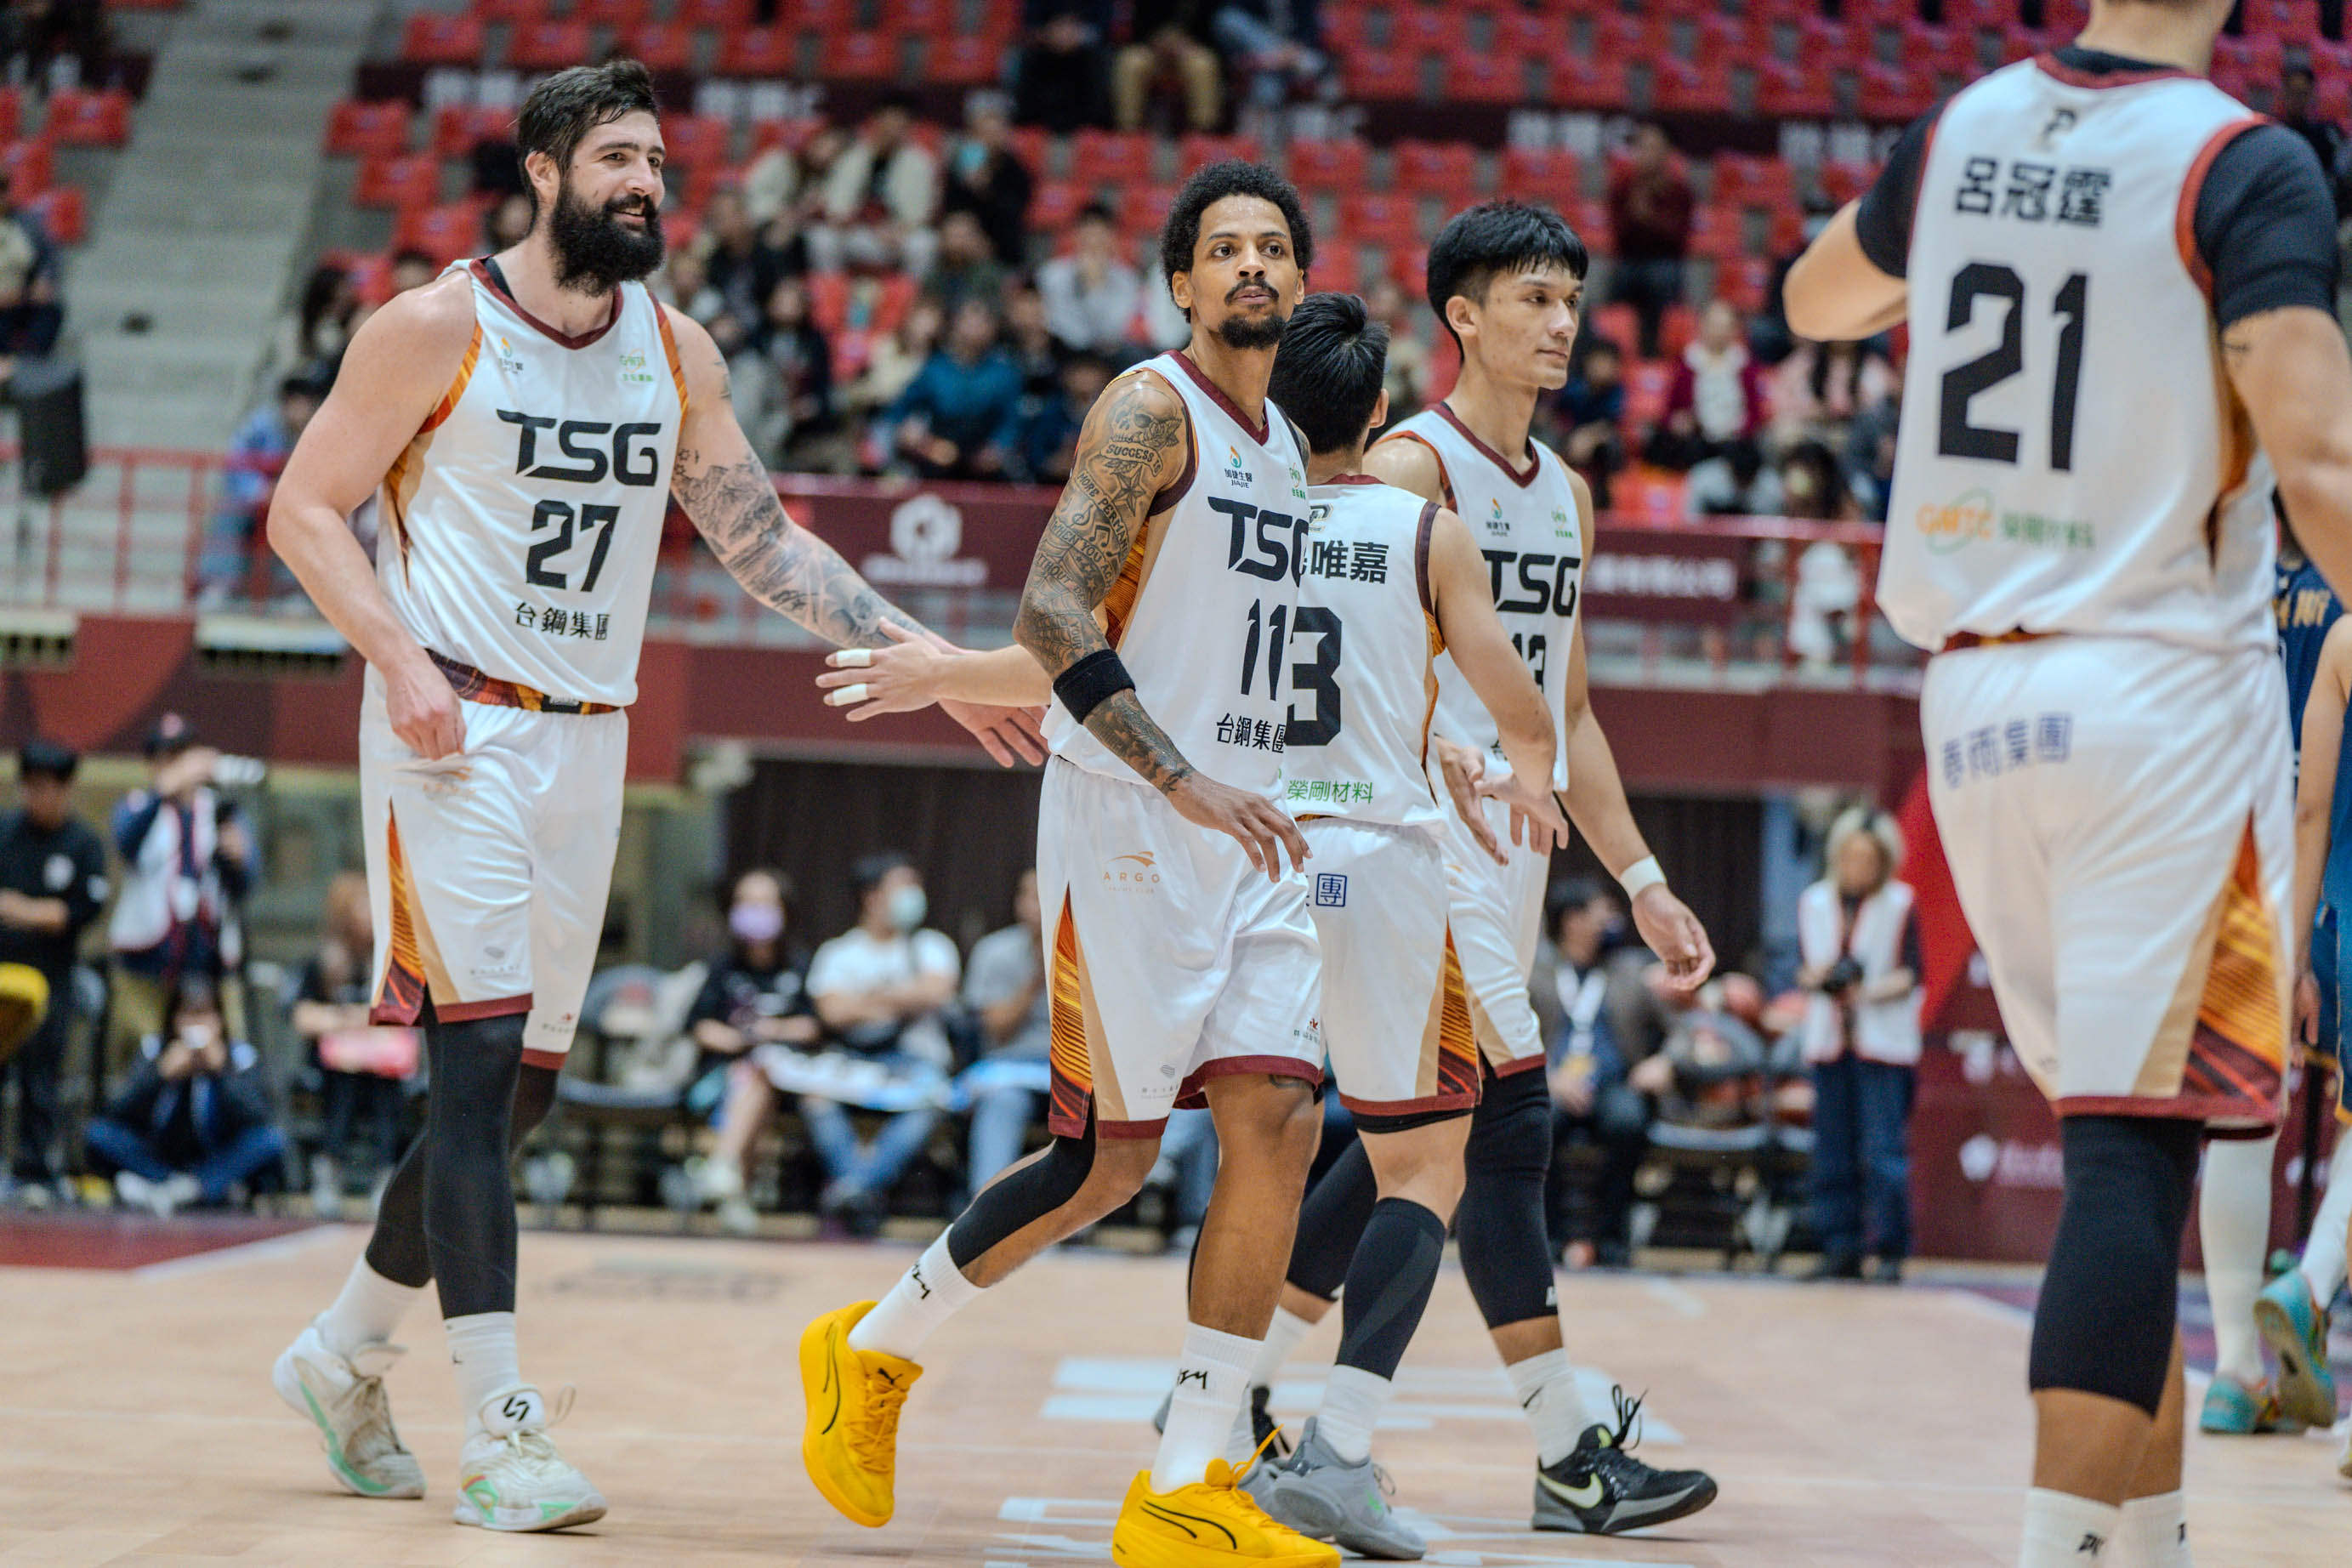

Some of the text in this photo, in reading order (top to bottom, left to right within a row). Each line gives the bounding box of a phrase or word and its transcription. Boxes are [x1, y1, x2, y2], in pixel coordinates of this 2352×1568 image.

[1938, 263, 2088, 472] 21
[496, 409, 662, 487] TSG
[1105, 444, 1155, 463] SUCCESS
[1077, 472, 1100, 497] MORE
[526, 498, 621, 593] 27
[1079, 540, 1102, 563] YOU
[1299, 539, 1389, 585] 唯嘉
[1480, 548, 1582, 618] TSG
[515, 601, 611, 641] 台鋼集團
[1241, 598, 1287, 702] 11
[1284, 605, 1343, 747] 3
[1216, 712, 1287, 754] 台鋼集團
[1286, 779, 1373, 804] 榮剛材料
[1103, 871, 1161, 884] ARGO
